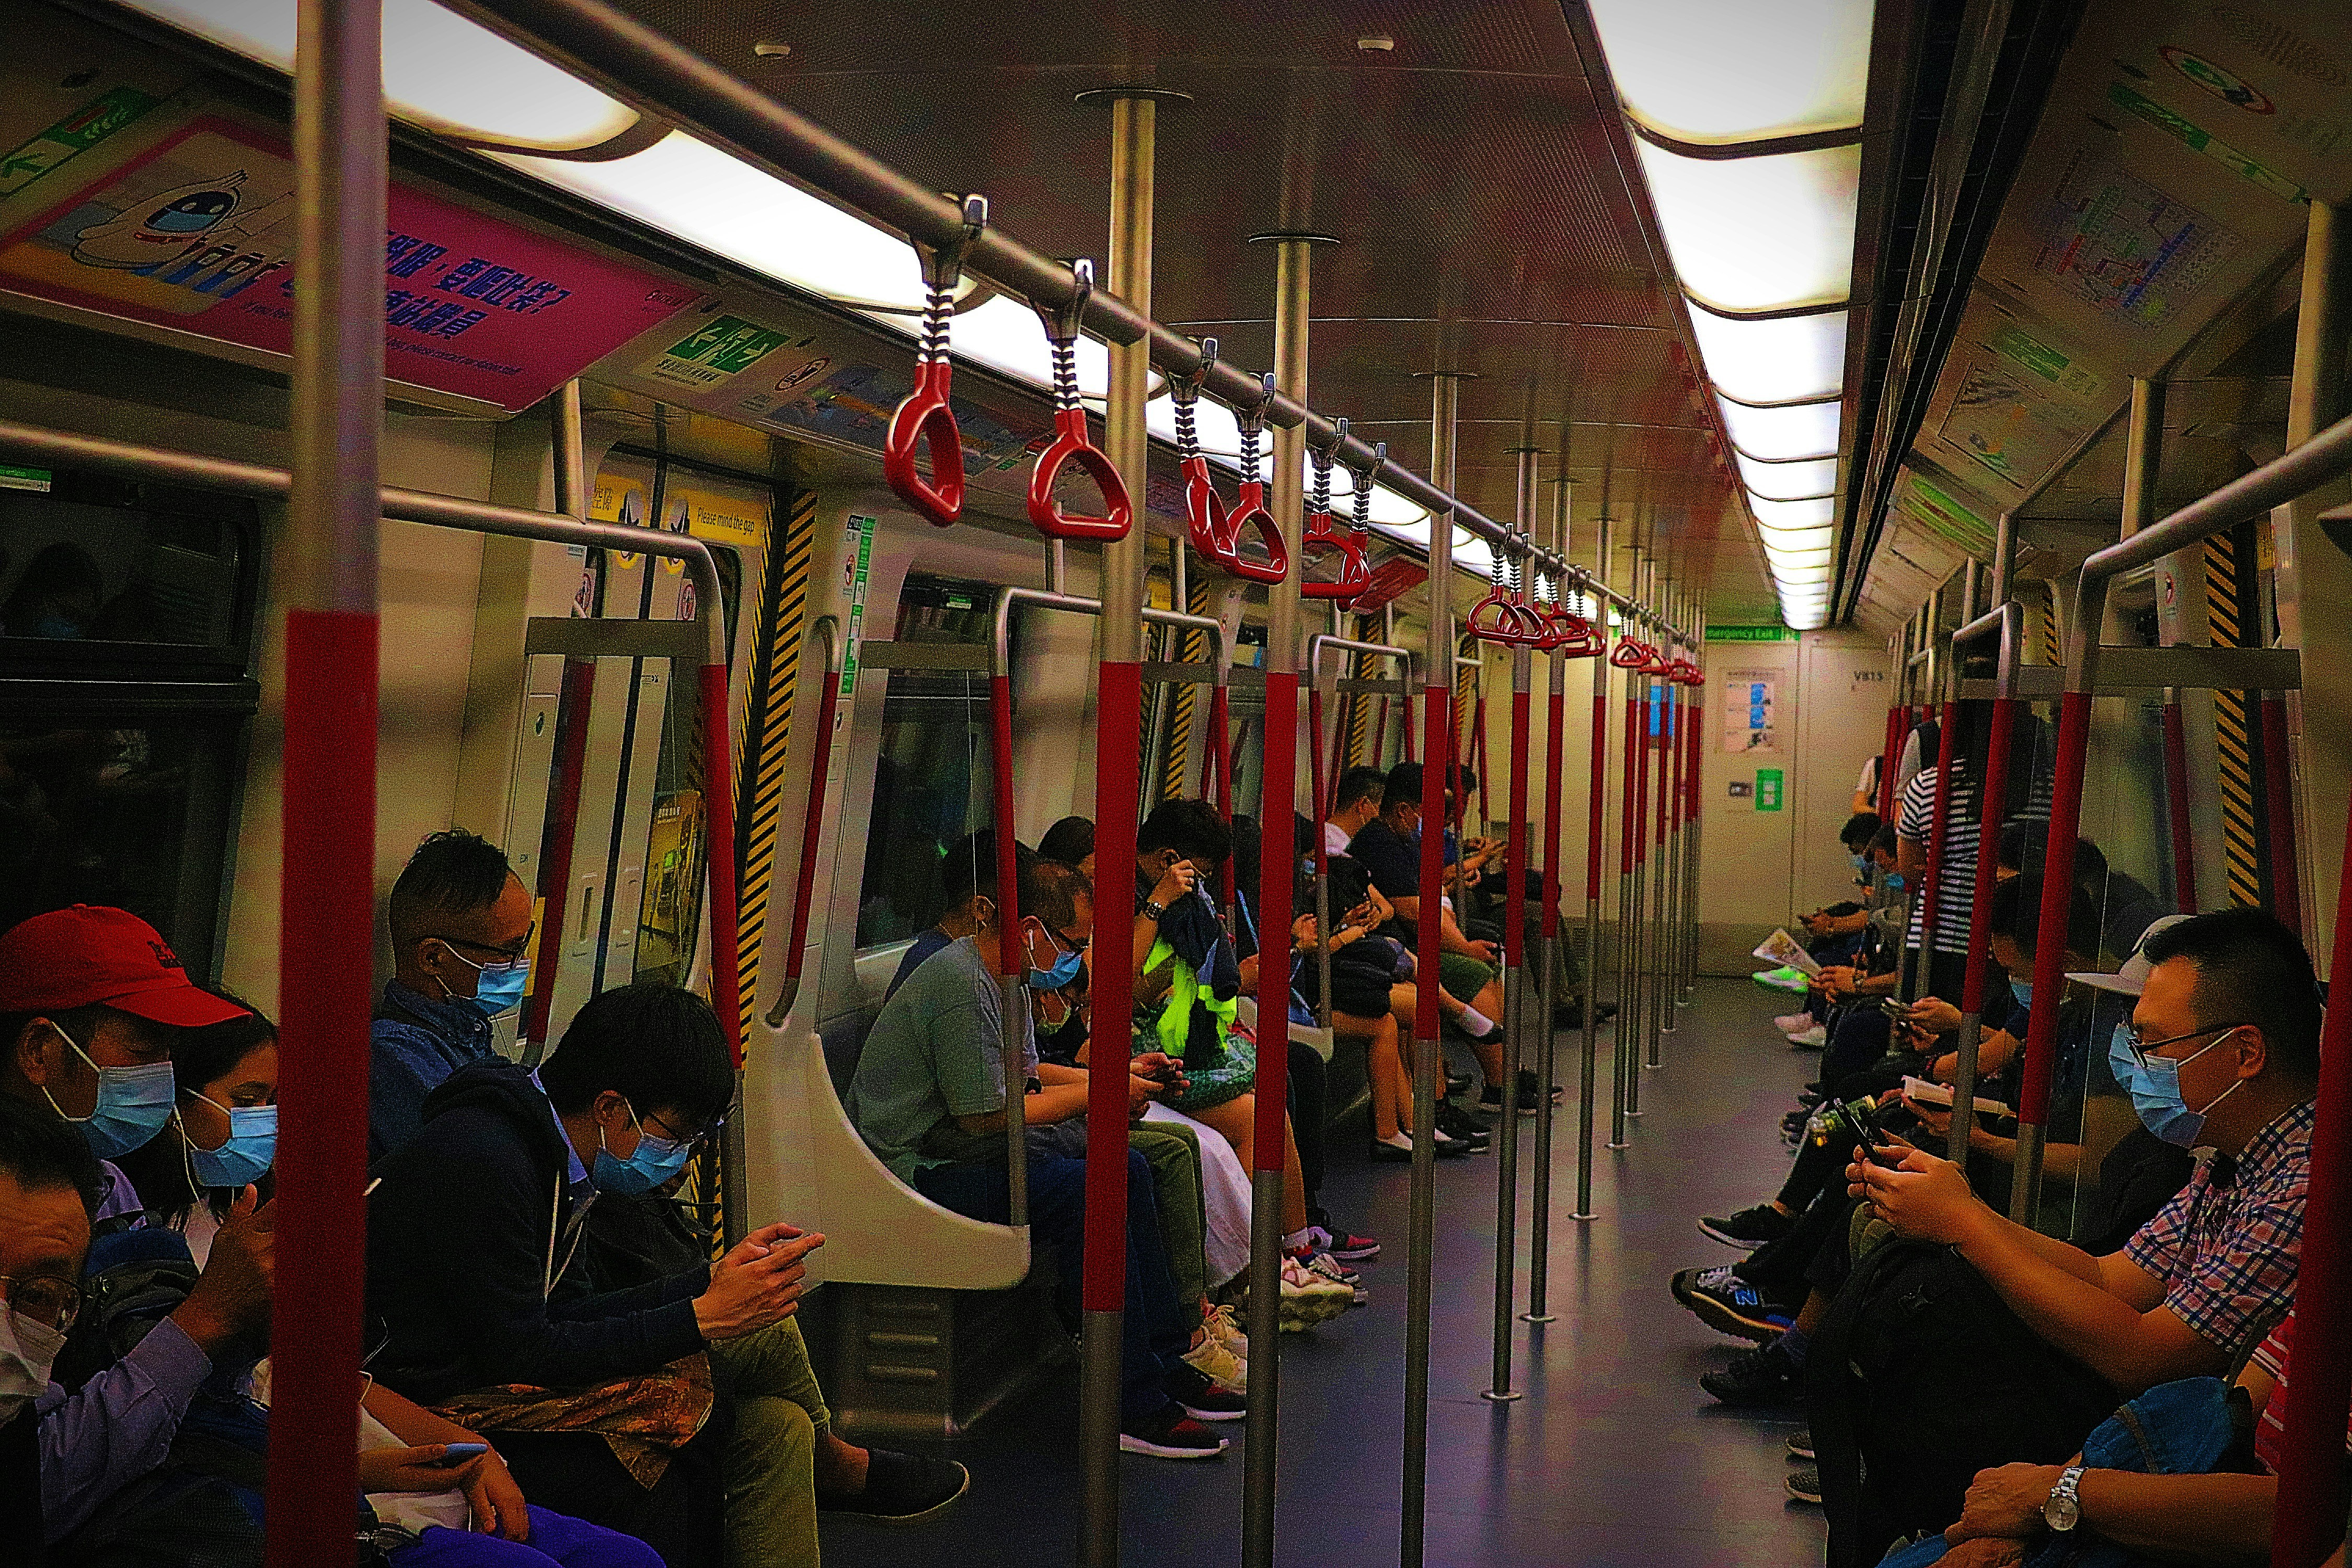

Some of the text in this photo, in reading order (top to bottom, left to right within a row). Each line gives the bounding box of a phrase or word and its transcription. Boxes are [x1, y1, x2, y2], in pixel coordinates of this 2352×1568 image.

[696, 506, 755, 536] Please mind the gap
[1707, 629, 1754, 640] mergency
